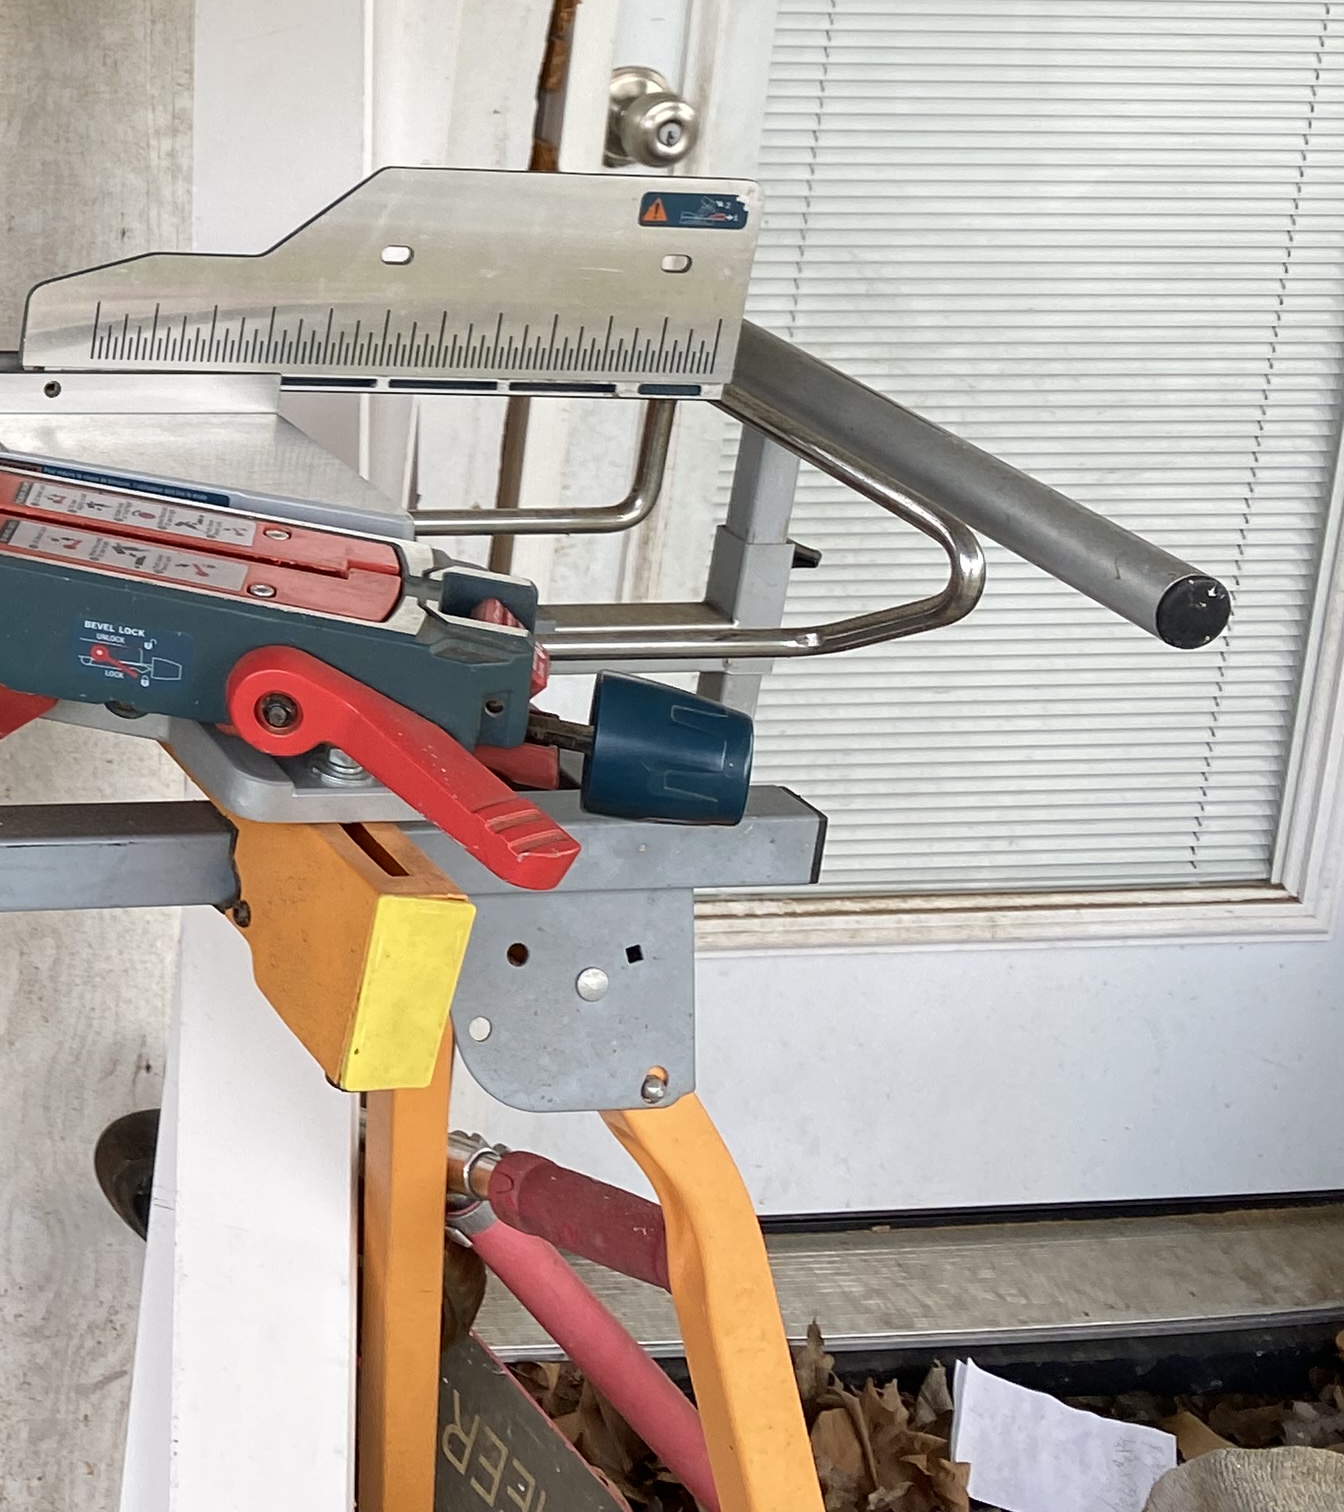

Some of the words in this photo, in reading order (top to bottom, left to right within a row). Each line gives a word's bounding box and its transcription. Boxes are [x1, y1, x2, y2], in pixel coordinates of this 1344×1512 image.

[84, 620, 115, 633] BEVEL
[118, 626, 146, 638] LOCK
[96, 632, 126, 644] UNLOCK
[104, 669, 125, 680] LOCK
[441, 1387, 548, 1512] EER
